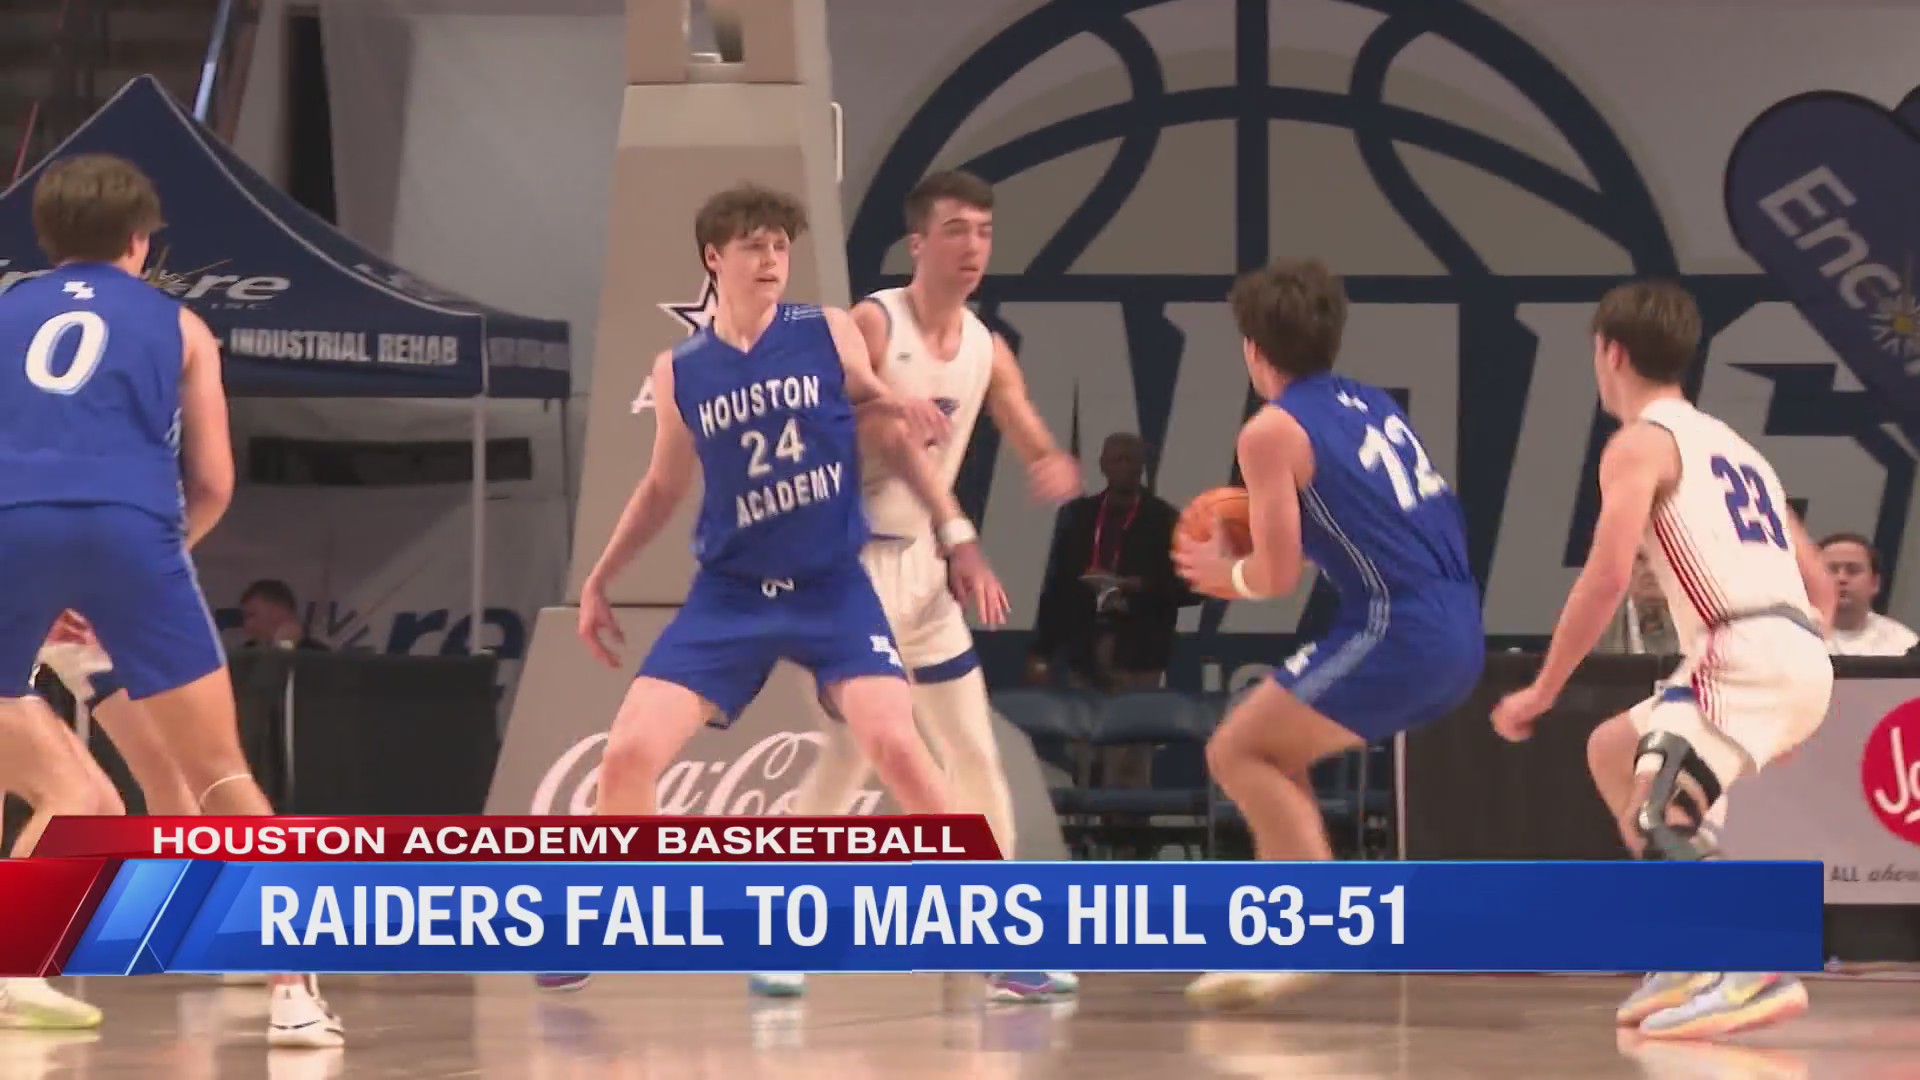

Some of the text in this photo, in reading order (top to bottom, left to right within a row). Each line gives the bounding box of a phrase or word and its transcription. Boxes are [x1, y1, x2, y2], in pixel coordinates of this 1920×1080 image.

[25, 310, 109, 396] 0
[230, 327, 371, 362] INDUSTRIAL
[377, 333, 458, 366] REHAB
[698, 375, 819, 437] HOUSTON
[740, 418, 806, 478] 24
[1358, 414, 1448, 512] 12
[735, 461, 843, 529] ACADEMY
[1710, 455, 1788, 551] 23
